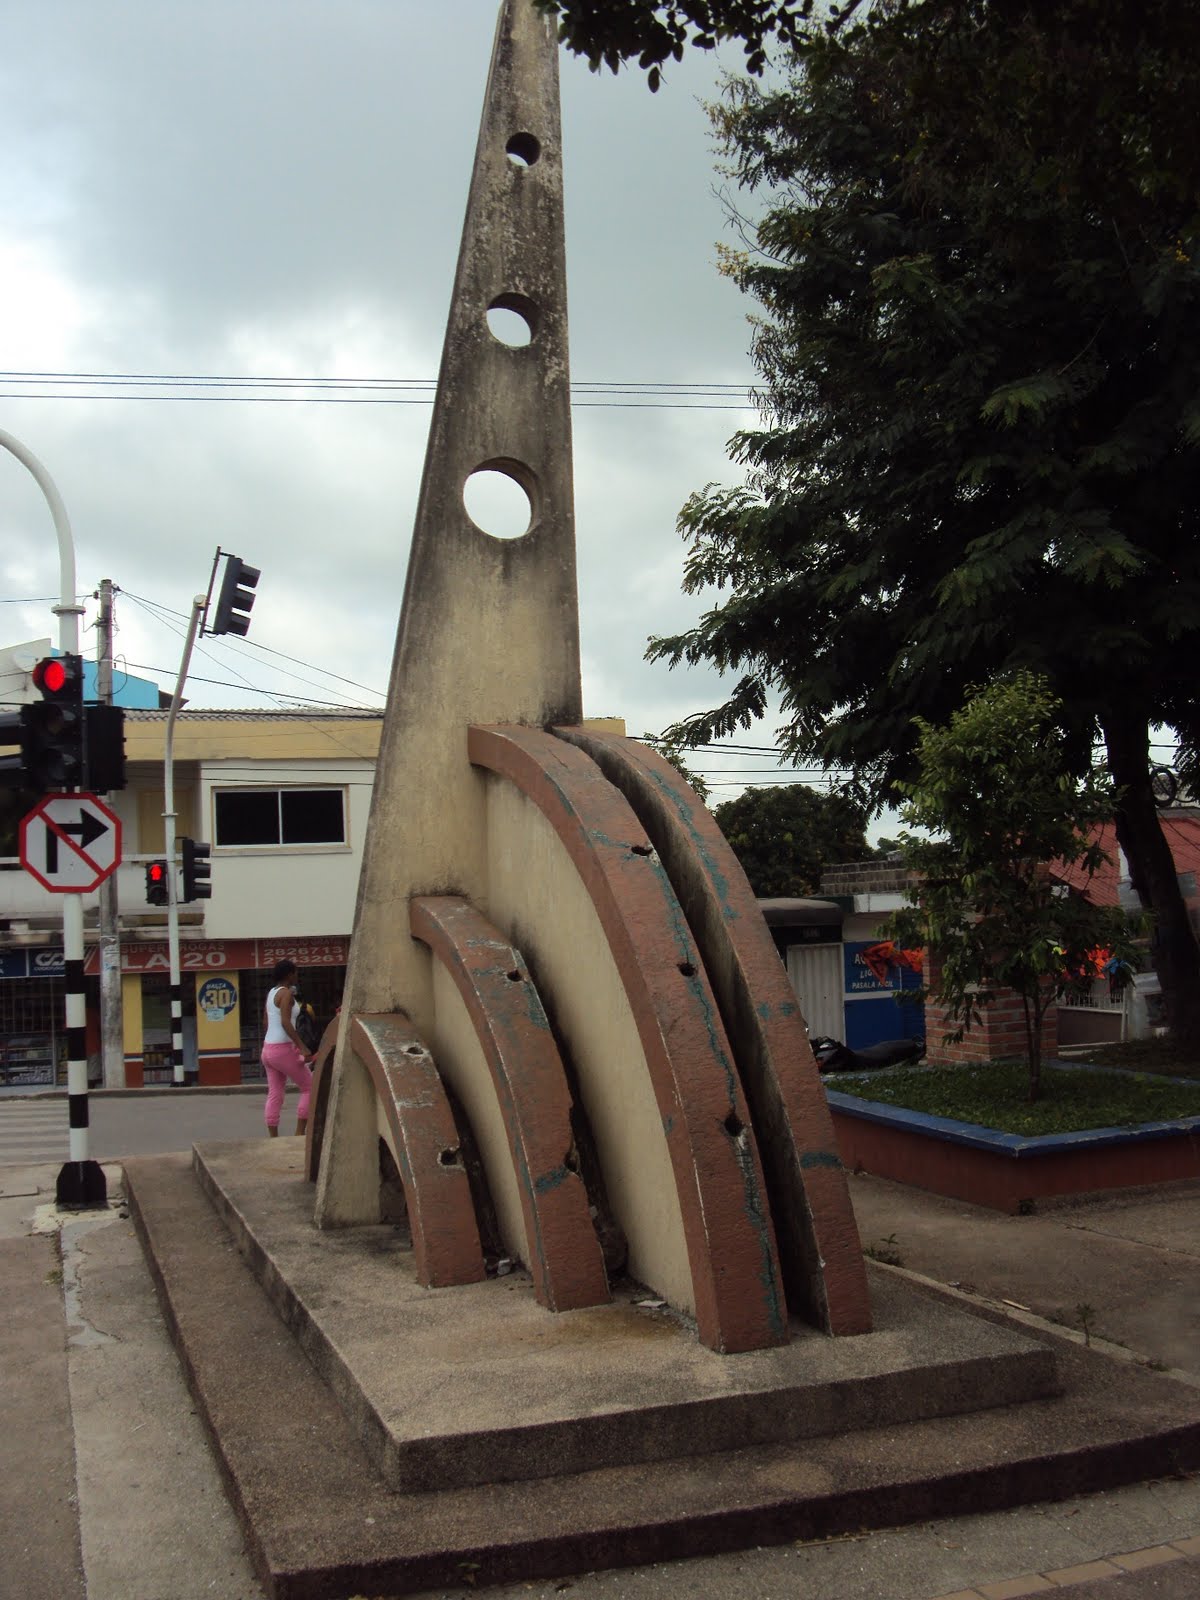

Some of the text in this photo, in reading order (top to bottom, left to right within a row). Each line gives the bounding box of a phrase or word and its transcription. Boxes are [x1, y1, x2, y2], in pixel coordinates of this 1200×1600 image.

[121, 942, 225, 953] SUPER ROGAS
[264, 946, 343, 957] 2826713
[121, 951, 227, 969] LA 20
[852, 980, 894, 990] PASALA FCIL
